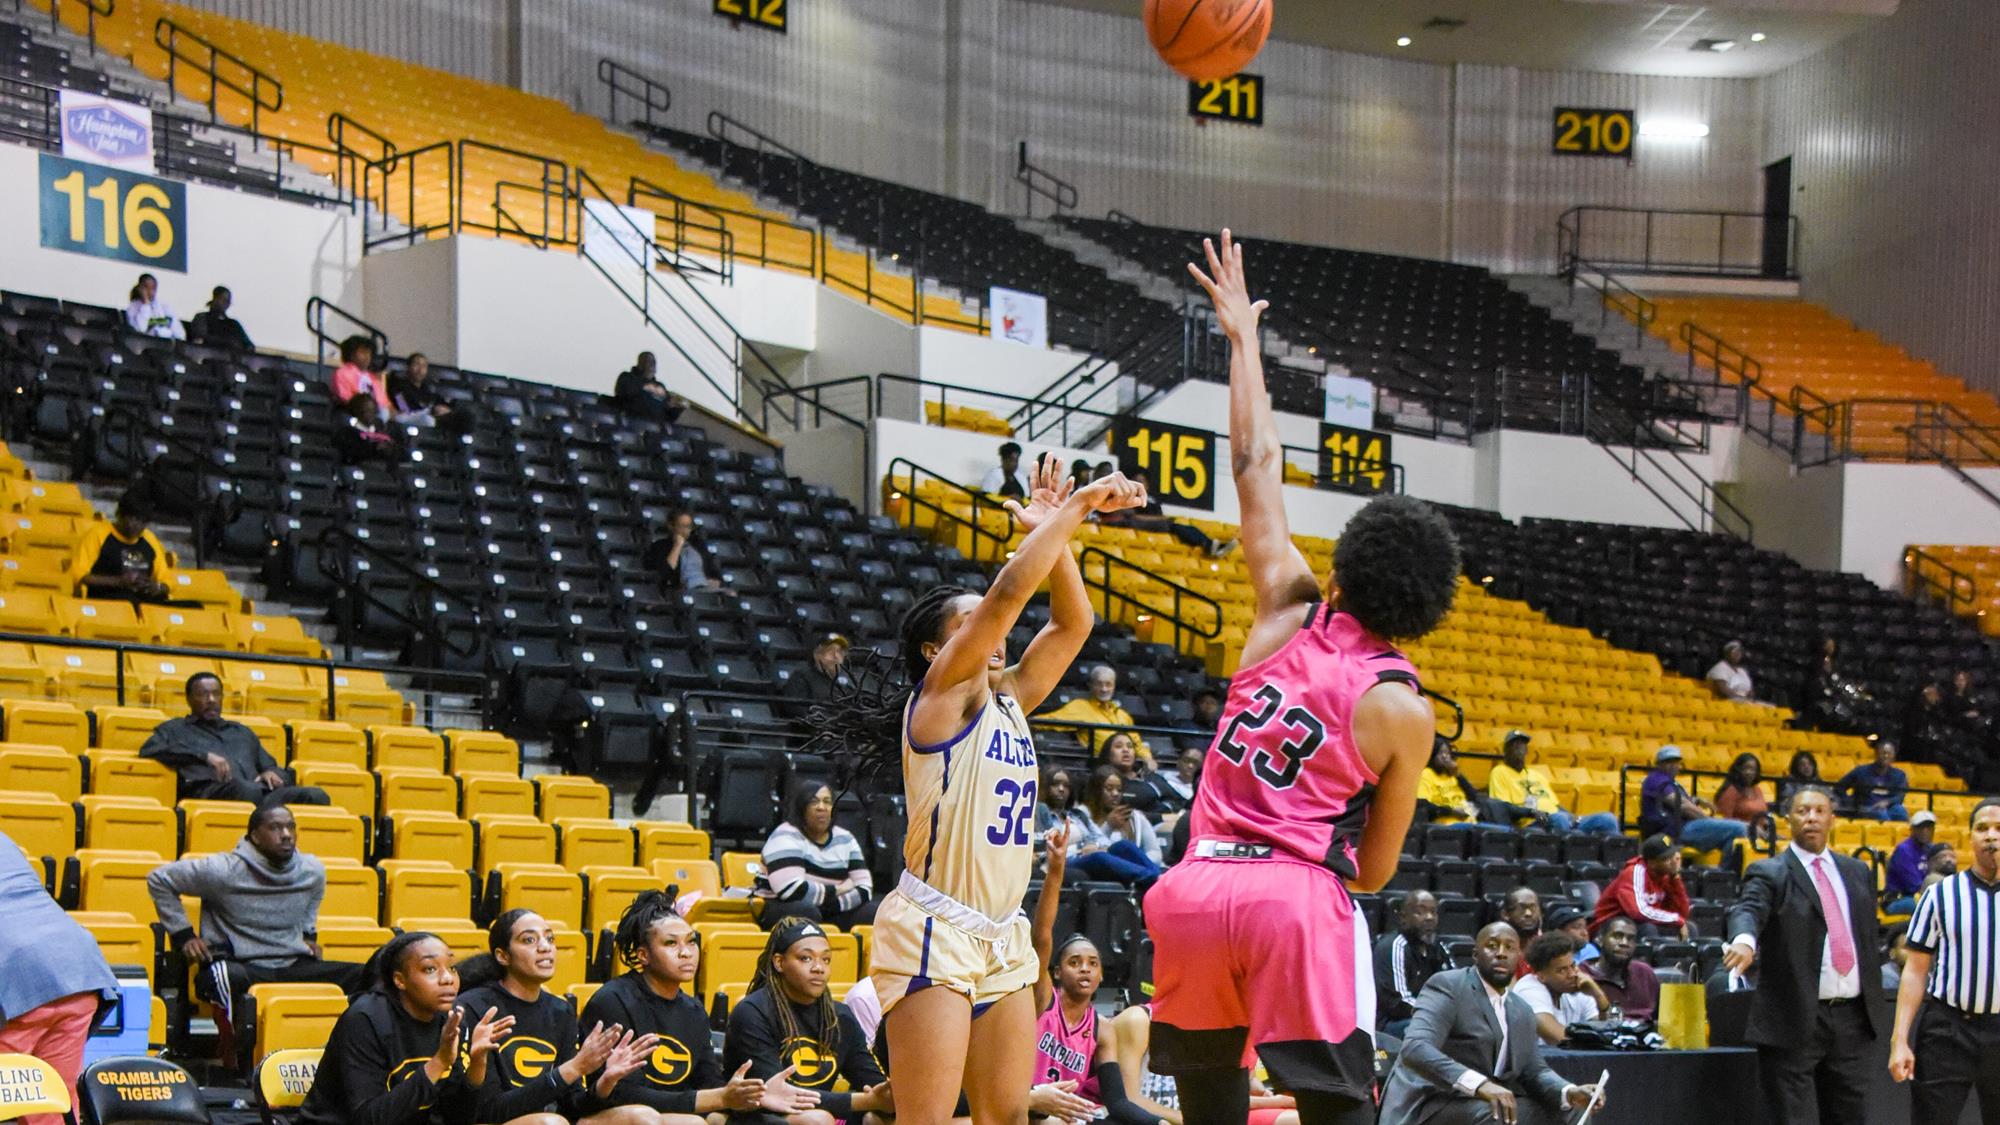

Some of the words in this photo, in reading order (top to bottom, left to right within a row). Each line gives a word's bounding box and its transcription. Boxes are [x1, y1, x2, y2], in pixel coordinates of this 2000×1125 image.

[1198, 78, 1256, 119] 211
[1556, 111, 1631, 153] 210
[53, 170, 174, 258] 116
[1128, 427, 1207, 499] 115
[1324, 431, 1386, 489] 114
[1216, 683, 1328, 791] 23
[986, 778, 1037, 846] 32
[2, 1086, 47, 1102] BALL
[97, 1070, 187, 1085] GRAMBLING
[117, 1086, 173, 1101] TIGERS
